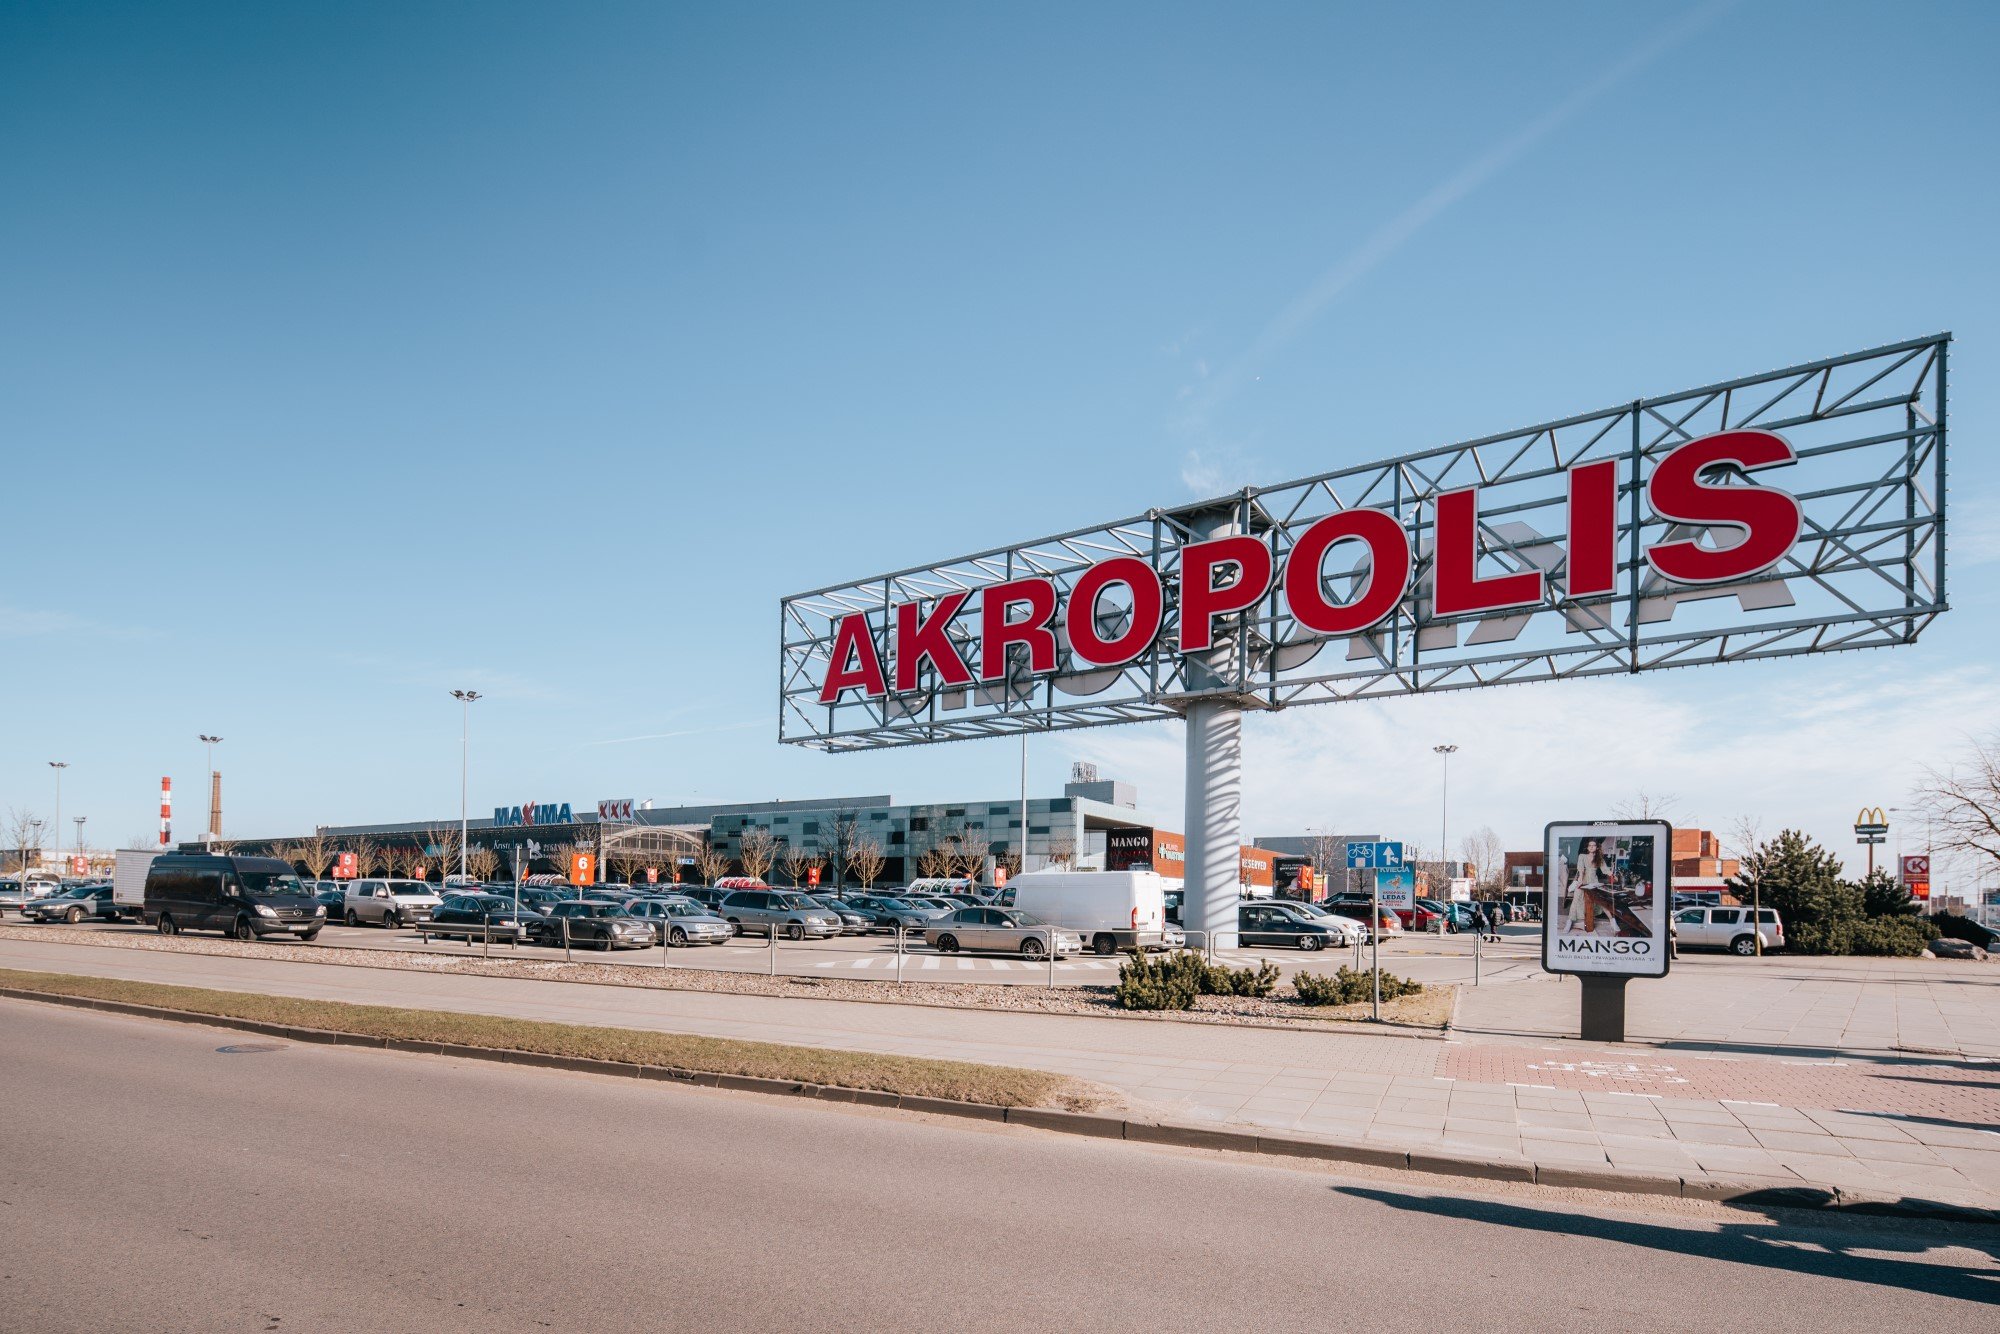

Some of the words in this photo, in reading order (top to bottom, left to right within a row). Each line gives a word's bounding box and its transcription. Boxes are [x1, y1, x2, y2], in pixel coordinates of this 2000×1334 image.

[818, 428, 1804, 705] AKROPOLIS
[494, 800, 574, 826] MAXIMA
[1111, 836, 1149, 848] MANGO
[77, 858, 83, 866] 3
[344, 855, 352, 865] 5
[578, 857, 588, 870] 6
[1241, 858, 1267, 871] RESERVED
[998, 869, 1004, 877] 6
[1305, 868, 1311, 878] 7
[1558, 939, 1651, 954] MANGO
